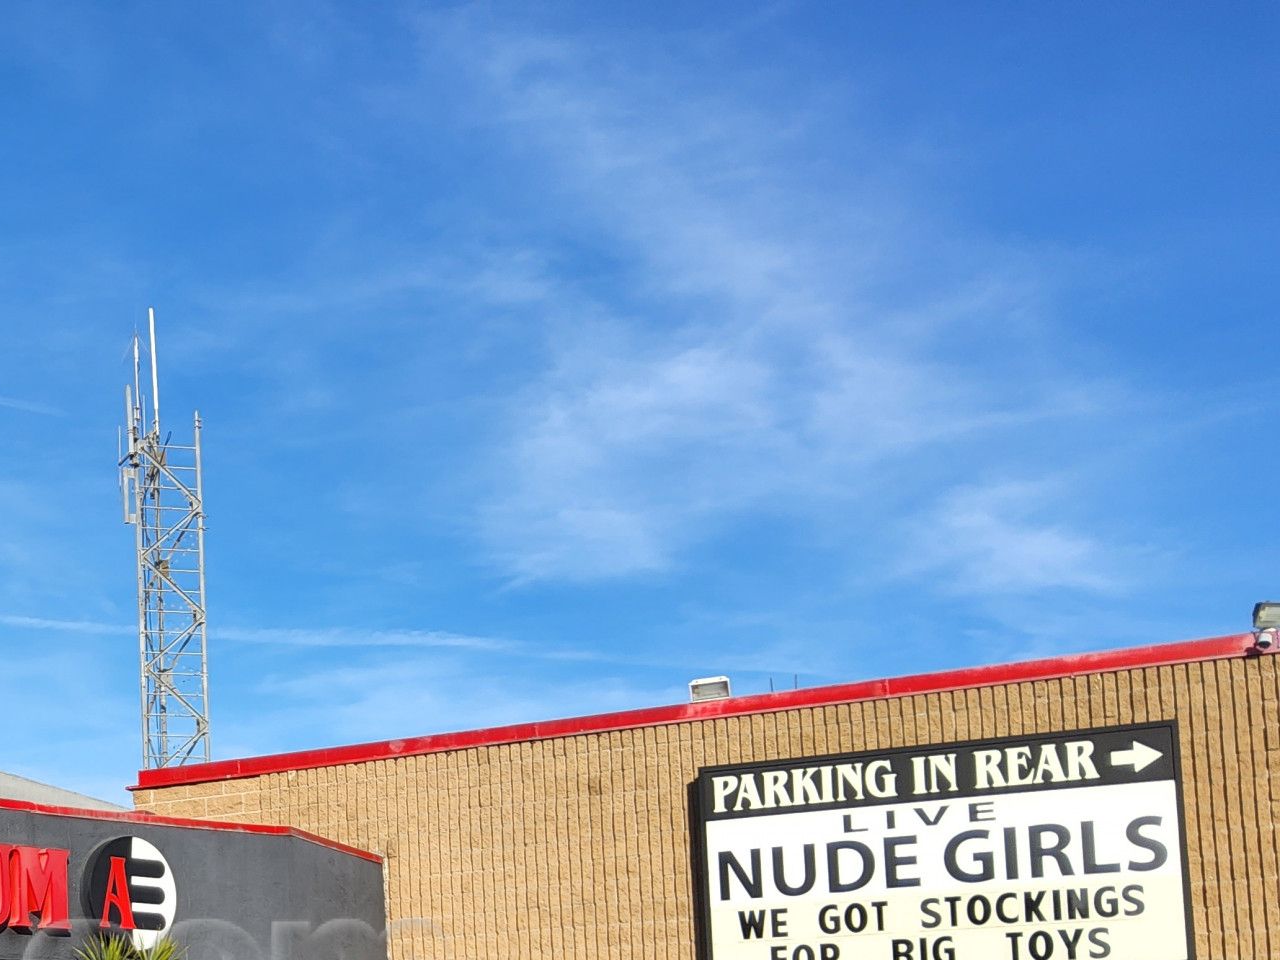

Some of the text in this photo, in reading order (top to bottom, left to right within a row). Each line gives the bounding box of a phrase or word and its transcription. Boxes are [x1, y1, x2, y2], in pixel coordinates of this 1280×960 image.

[712, 740, 1101, 813] PARKING IN REAR
[842, 802, 996, 833] LIVE
[718, 815, 1168, 900] NUDE GIRLS
[738, 884, 1145, 940] WE GOT STOCKINGS
